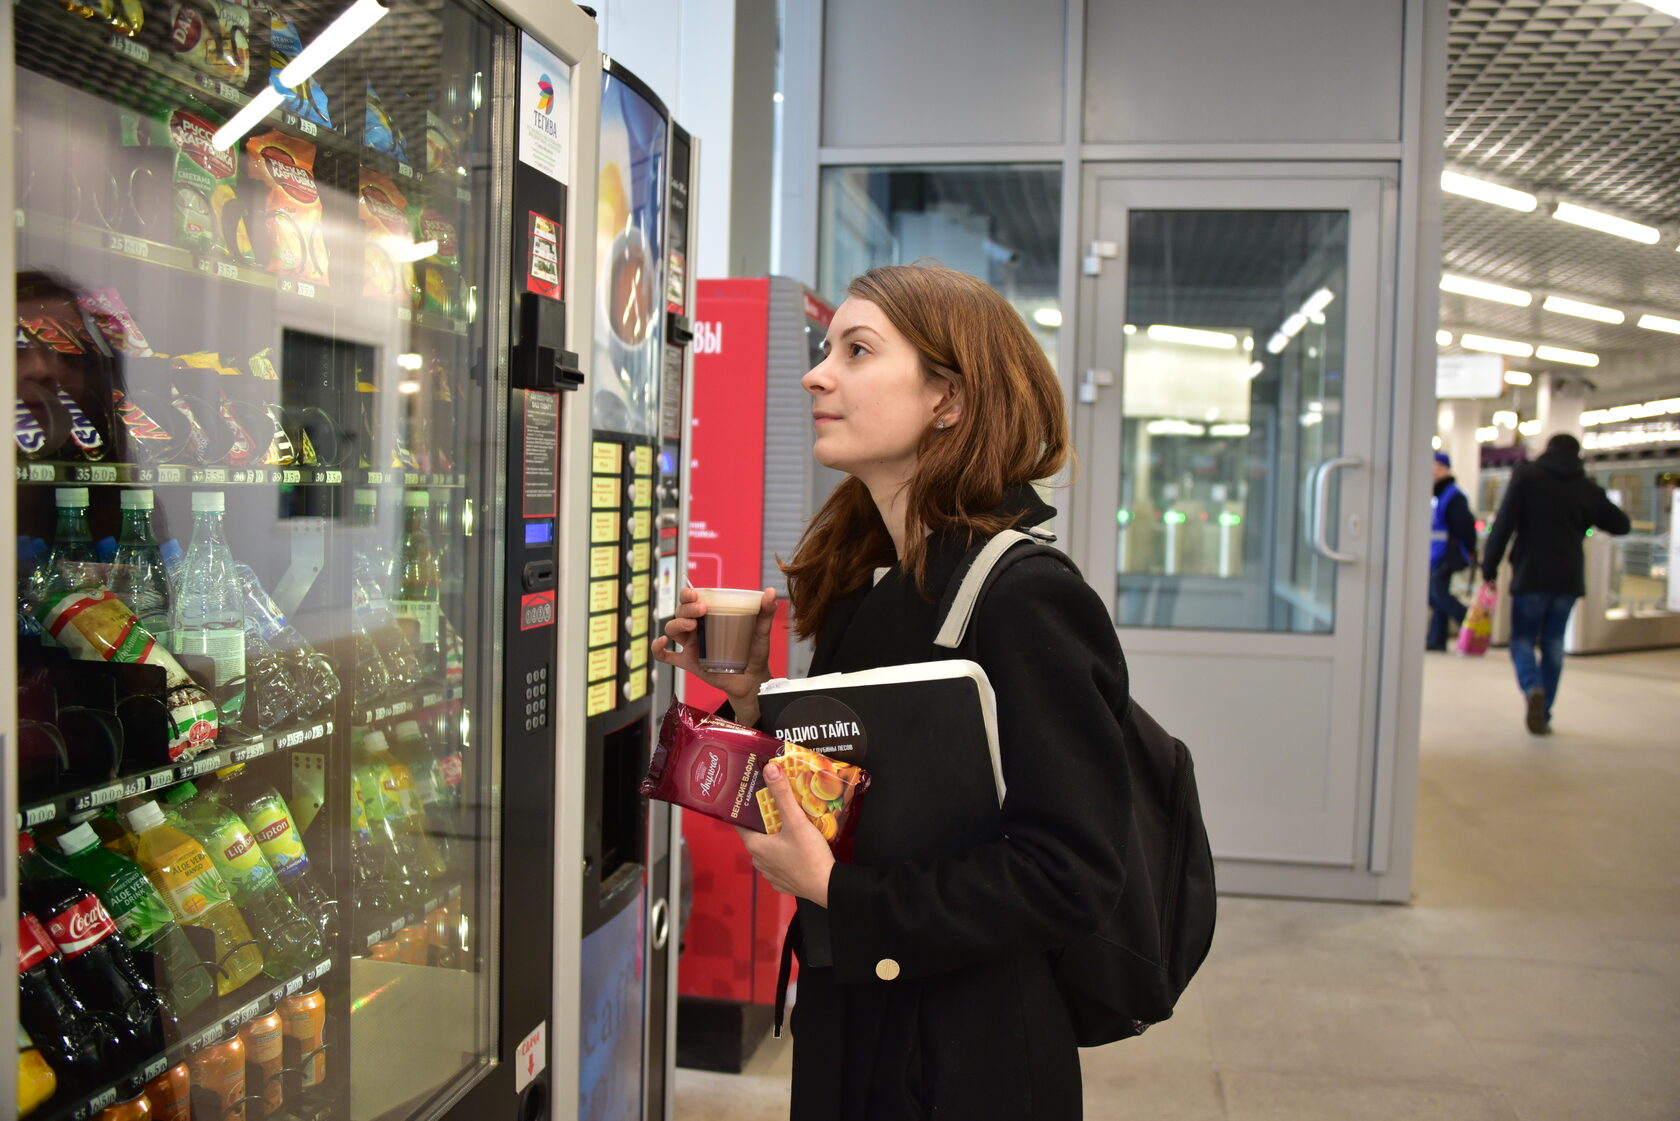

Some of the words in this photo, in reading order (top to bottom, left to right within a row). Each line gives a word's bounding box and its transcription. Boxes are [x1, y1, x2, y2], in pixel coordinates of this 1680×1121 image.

[533, 110, 558, 139] ТЕГИВА
[77, 468, 91, 480] 35
[140, 470, 151, 481] 36
[776, 725, 819, 743] РАДИО
[820, 720, 860, 739] ТАЙГА
[700, 751, 719, 797] Акульчев
[730, 781, 748, 819] ВЕНСКИЕ
[742, 752, 757, 782] ВАФЛИ
[125, 783, 137, 796] 46
[745, 770, 759, 802] АБРИКОСОМ
[78, 795, 91, 809] 45
[256, 820, 289, 843] Lipton
[226, 834, 254, 858] Lipton
[172, 860, 190, 876] ALOE
[184, 863, 204, 877] MANGO
[111, 887, 132, 908] ALOE
[130, 876, 149, 893] VER
[124, 887, 146, 906] DRINK
